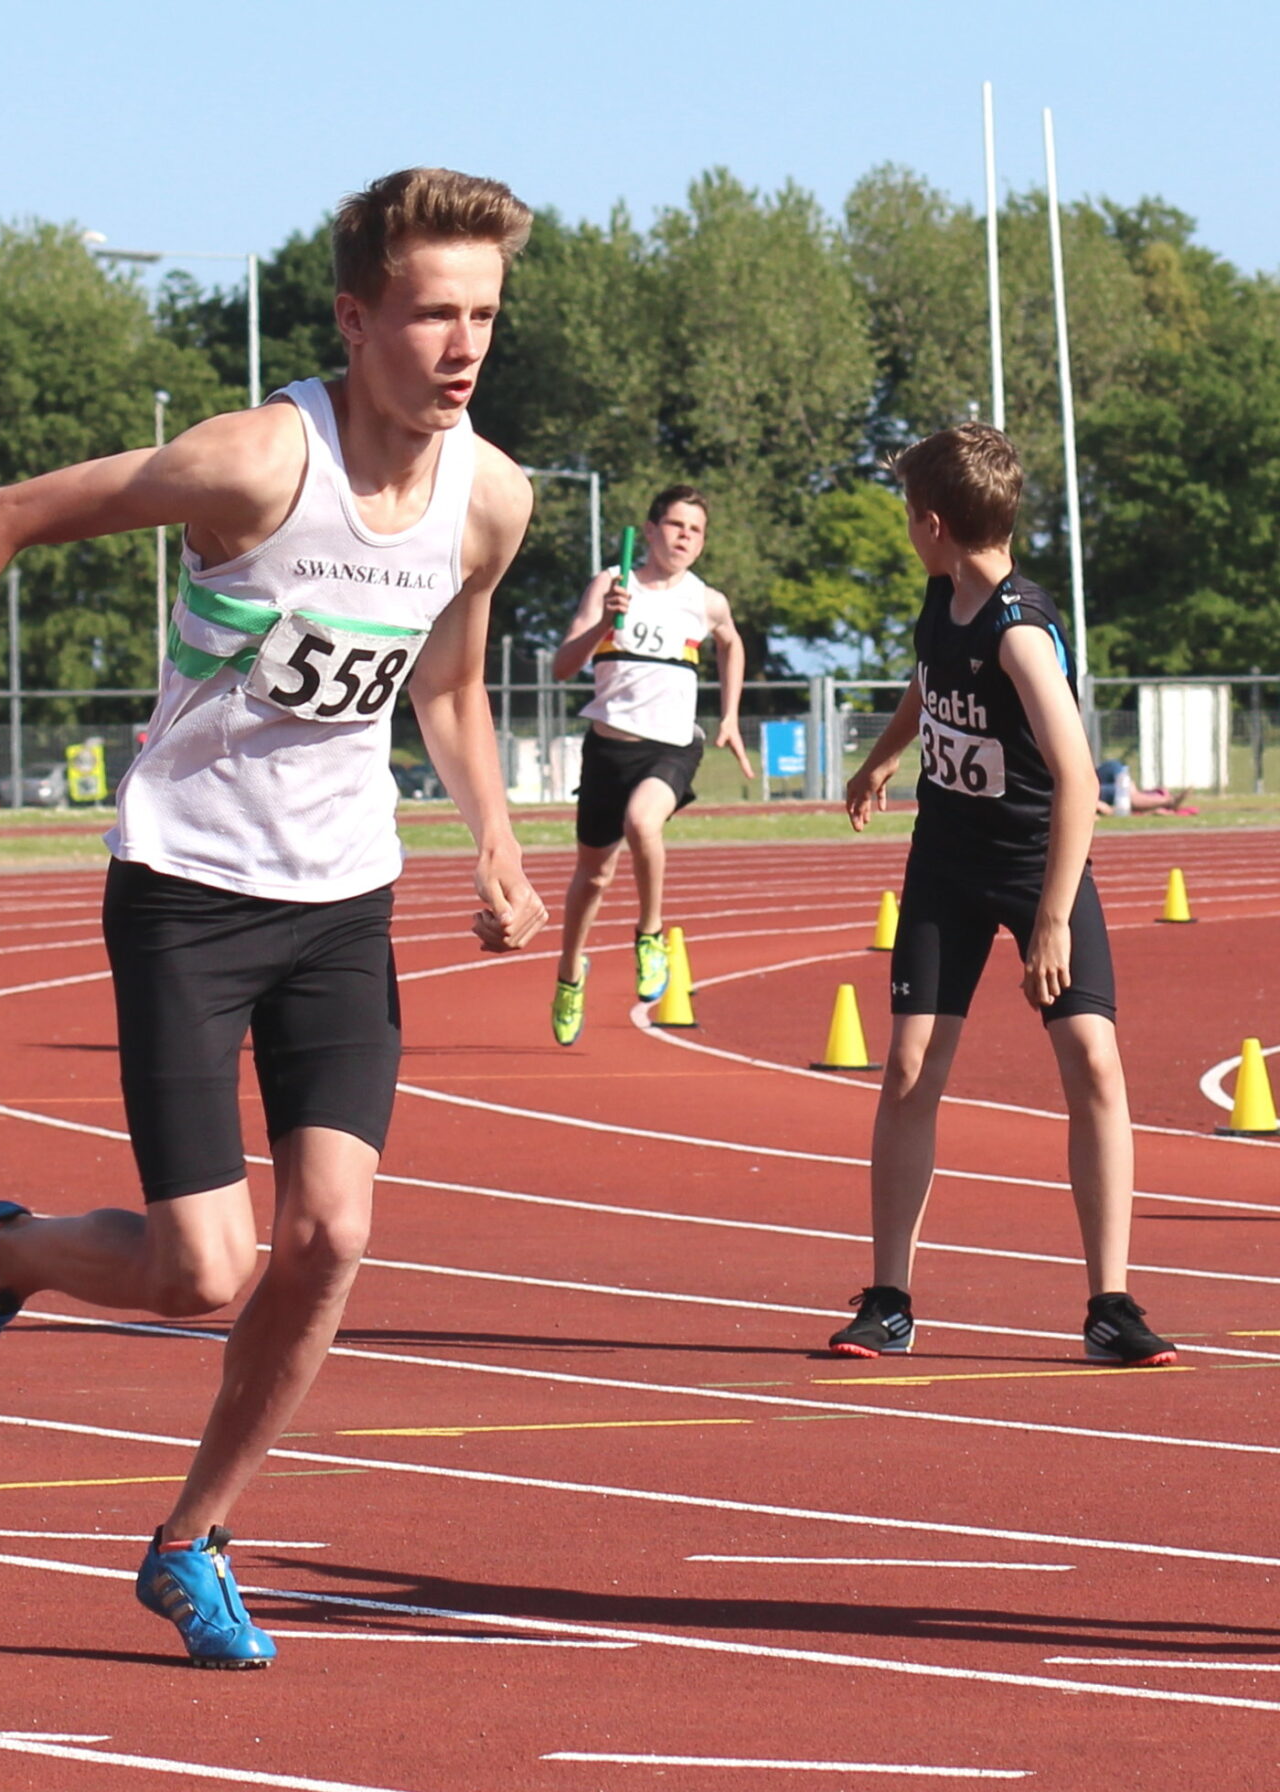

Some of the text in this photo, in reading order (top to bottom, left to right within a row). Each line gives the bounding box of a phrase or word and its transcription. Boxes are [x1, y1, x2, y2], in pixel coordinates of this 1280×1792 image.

[294, 558, 391, 588] SWANSEA
[632, 622, 664, 652] 95
[268, 633, 408, 716] 558
[918, 660, 988, 729] Neath
[921, 723, 988, 792] 356
